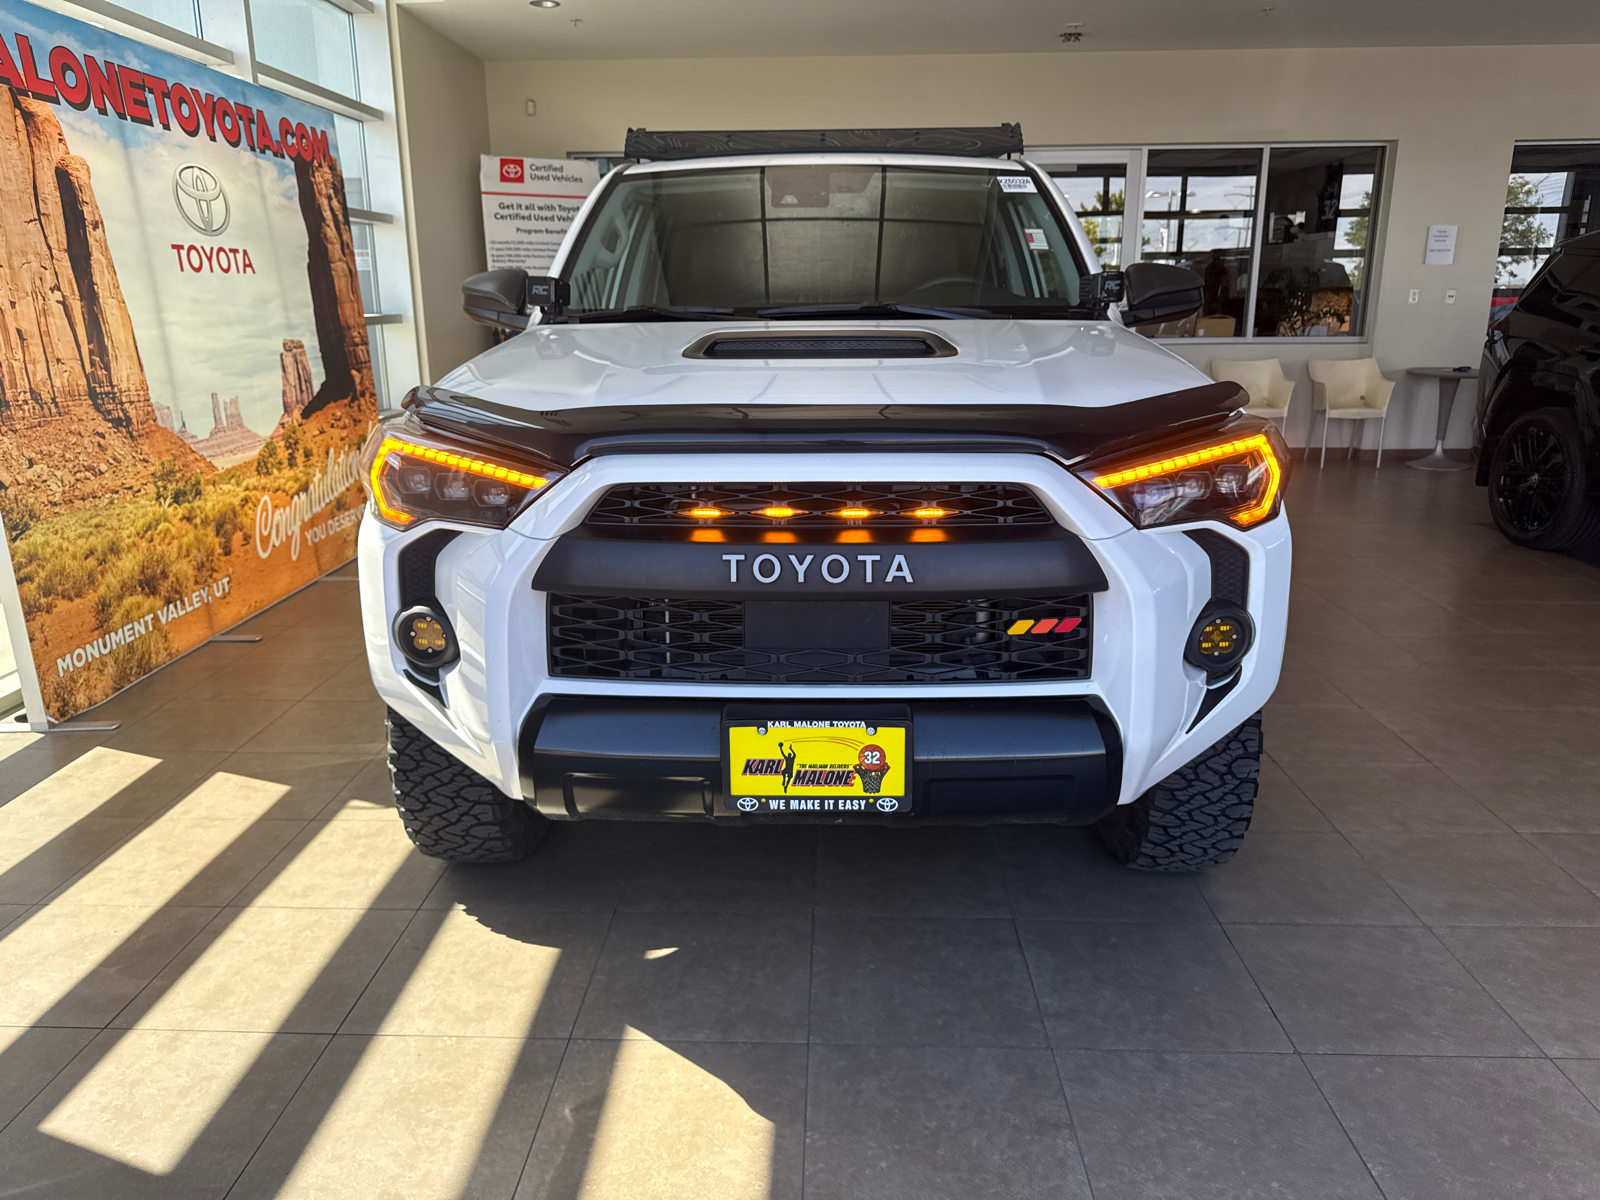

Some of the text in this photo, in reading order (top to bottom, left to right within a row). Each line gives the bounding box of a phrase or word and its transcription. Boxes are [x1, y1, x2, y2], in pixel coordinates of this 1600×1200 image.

[529, 163, 564, 173] Certified
[530, 173, 584, 183] Used Vehicles
[498, 201, 580, 214] Get it all with Toyot
[1321, 200, 1338, 220] 32
[493, 212, 574, 223] Certified Used Vehi
[516, 227, 545, 235] Program
[171, 243, 257, 275] TOYOTA
[532, 284, 549, 295] RC
[1104, 280, 1121, 290] RC
[256, 442, 364, 561] Congratulatio
[304, 503, 365, 546] YOU DESERV
[721, 553, 914, 584] TOYOTA
[56, 577, 230, 677] MONUMENT VALLEY, UT
[767, 720, 867, 728] KARL MALONE TOYOTA
[863, 751, 880, 764] 32
[741, 758, 784, 775] KARL
[792, 769, 855, 787] MALONE
[769, 799, 866, 810] WE MAKE IT EASY
